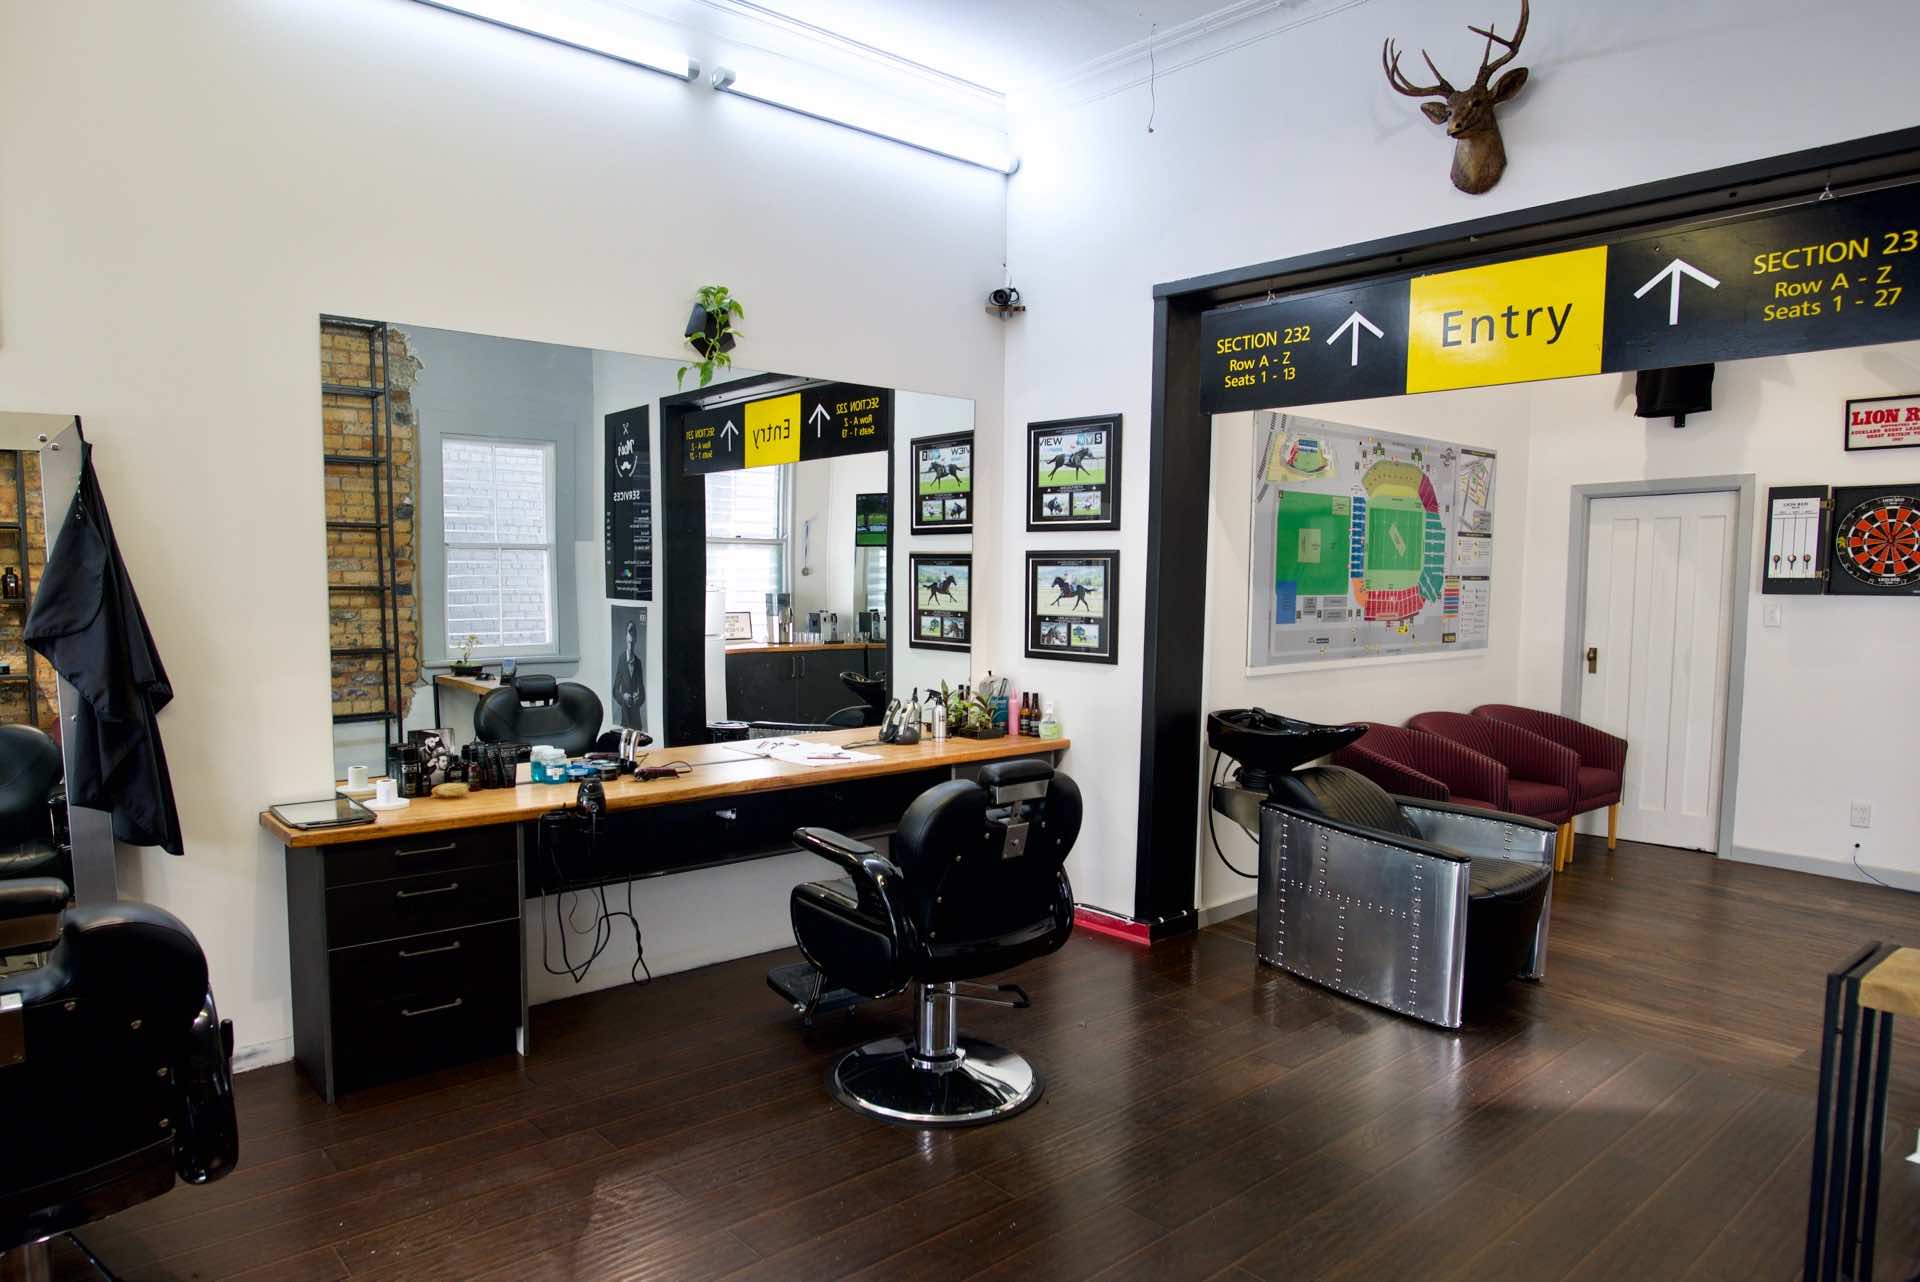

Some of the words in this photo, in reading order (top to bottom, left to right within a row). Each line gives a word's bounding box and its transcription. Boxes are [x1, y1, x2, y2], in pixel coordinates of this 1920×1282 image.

[1752, 237, 1869, 275] SECTION
[1775, 280, 1822, 298] Row
[1831, 272, 1849, 290] A
[1876, 266, 1893, 284] Z
[1763, 300, 1822, 321] Seats
[1832, 295, 1841, 312] 1
[1874, 287, 1903, 307] 27
[1216, 331, 1278, 354] SECTION
[1283, 326, 1311, 343] 232
[1442, 303, 1573, 348] Entry
[1229, 359, 1255, 372] Row
[1259, 355, 1269, 367] A
[1282, 352, 1291, 364] Z
[1224, 374, 1256, 388] Seats
[1260, 371, 1266, 383] 1
[1283, 367, 1296, 381] 13
[1851, 408, 1900, 426] LION
